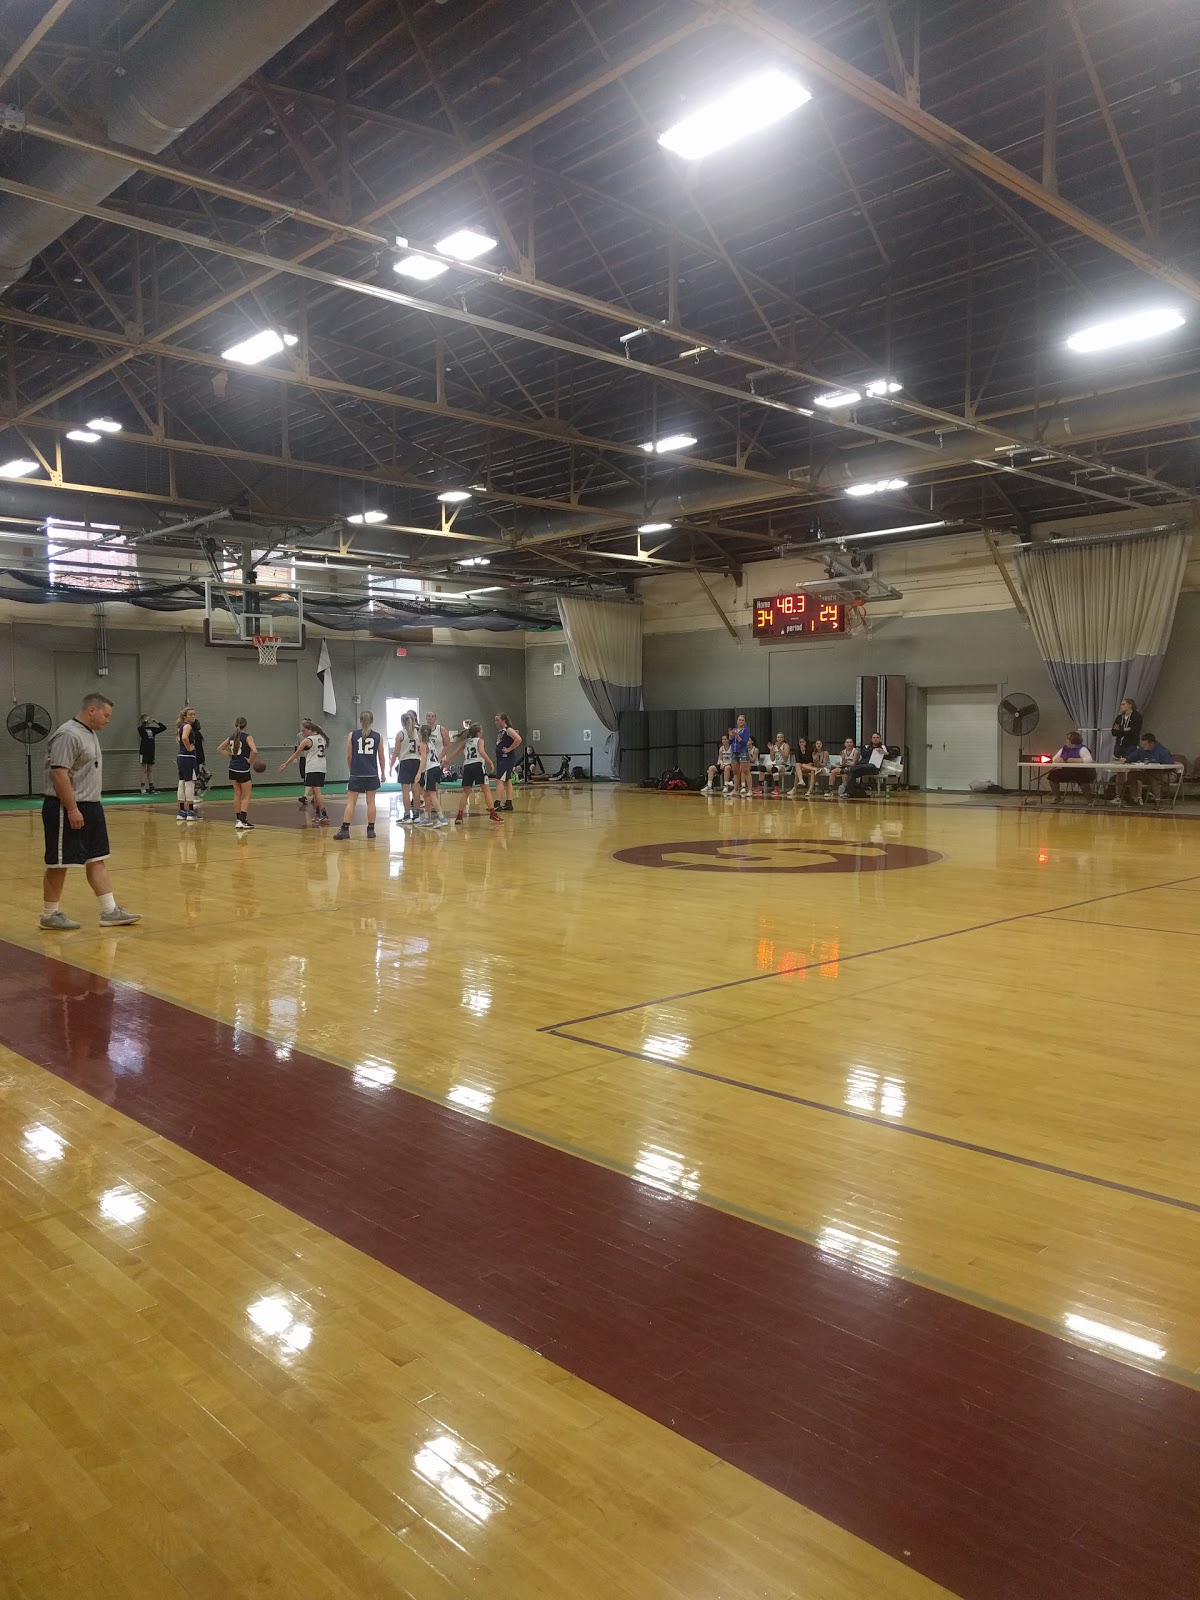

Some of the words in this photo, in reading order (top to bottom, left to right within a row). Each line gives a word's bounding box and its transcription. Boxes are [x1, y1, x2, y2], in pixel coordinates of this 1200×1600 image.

[757, 601, 771, 609] Home
[777, 595, 805, 614] 48.3
[757, 609, 773, 627] 34
[786, 623, 803, 633] period
[356, 736, 375, 755] 12
[408, 739, 417, 754] 3
[466, 746, 478, 760] 12
